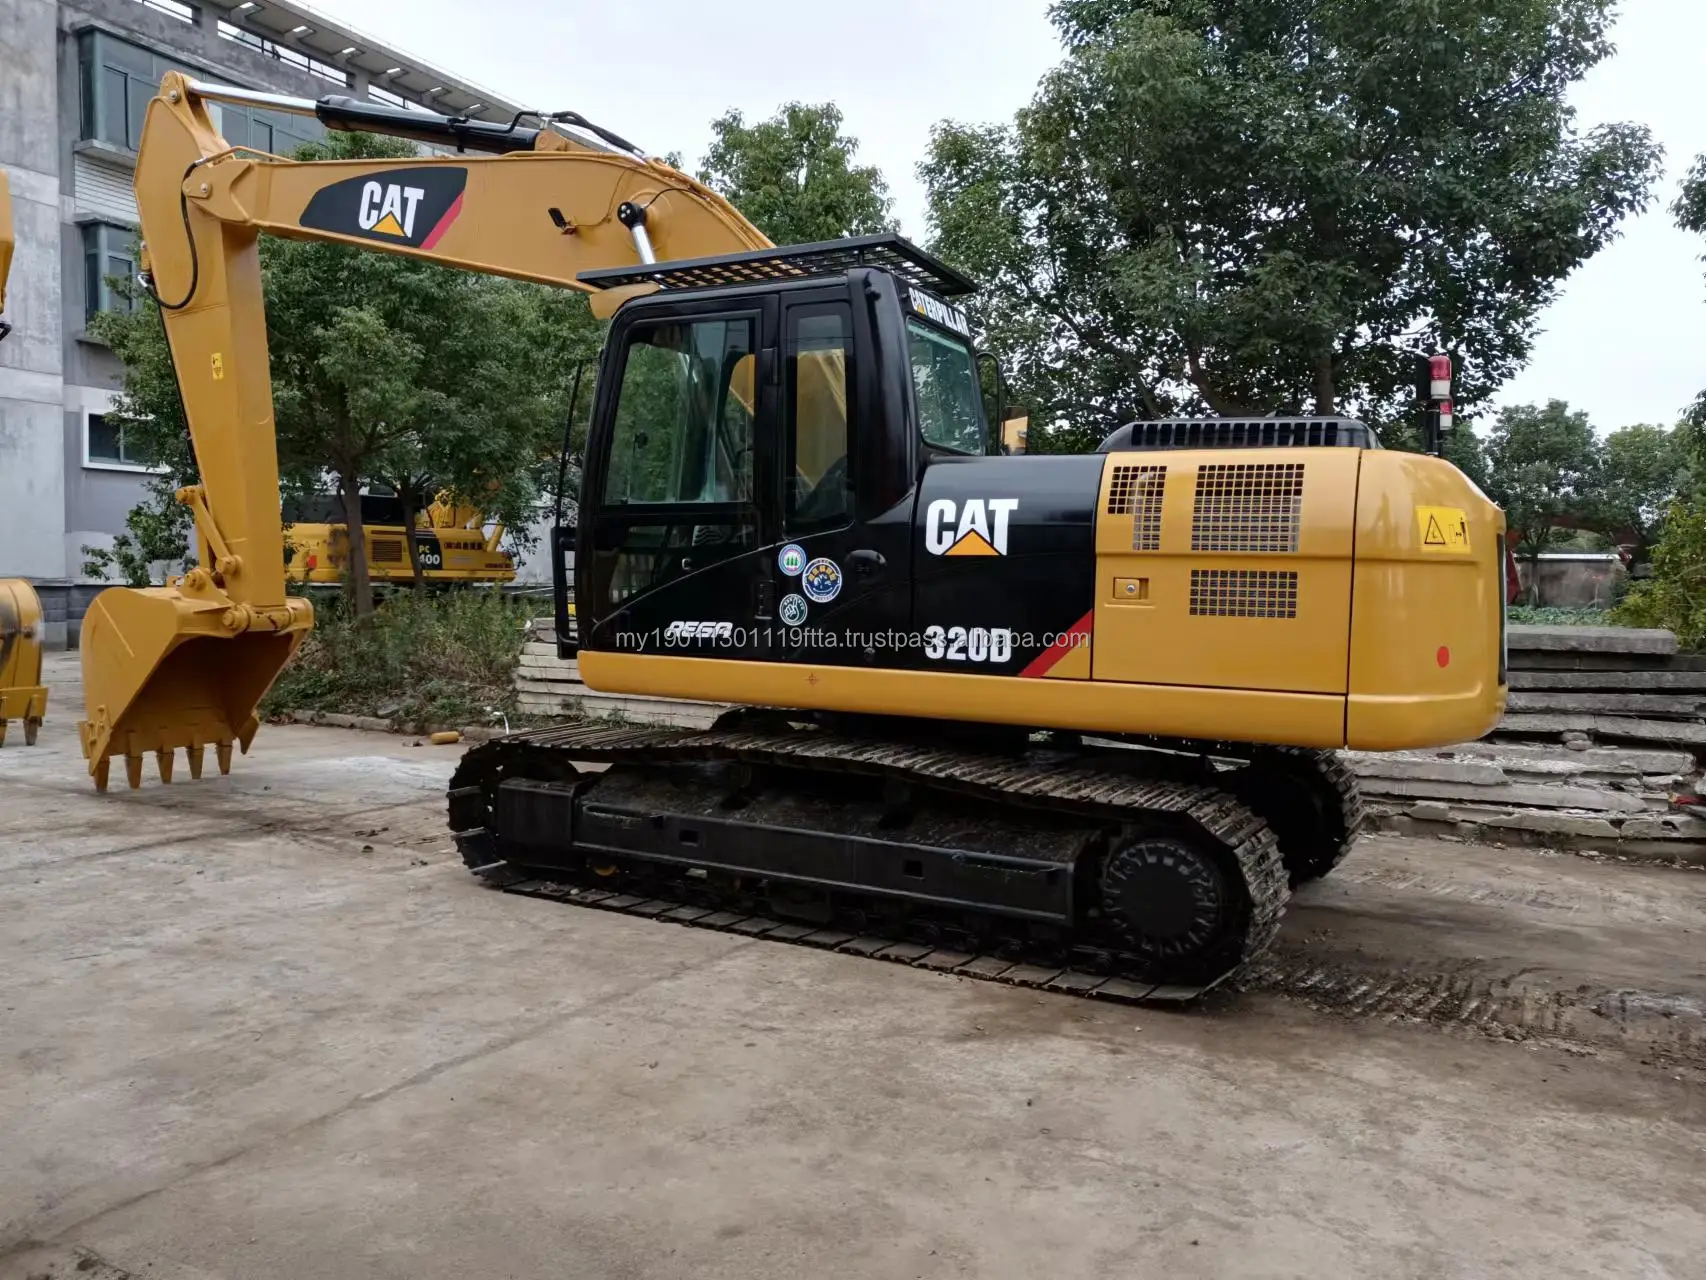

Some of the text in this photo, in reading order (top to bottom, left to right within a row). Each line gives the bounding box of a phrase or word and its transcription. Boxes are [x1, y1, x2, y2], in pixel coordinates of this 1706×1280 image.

[358, 180, 425, 238] CAT
[908, 286, 971, 338] CATERPILLAR
[418, 545, 431, 554] PC
[925, 498, 1019, 556] CAT
[924, 625, 1012, 663] 320D
